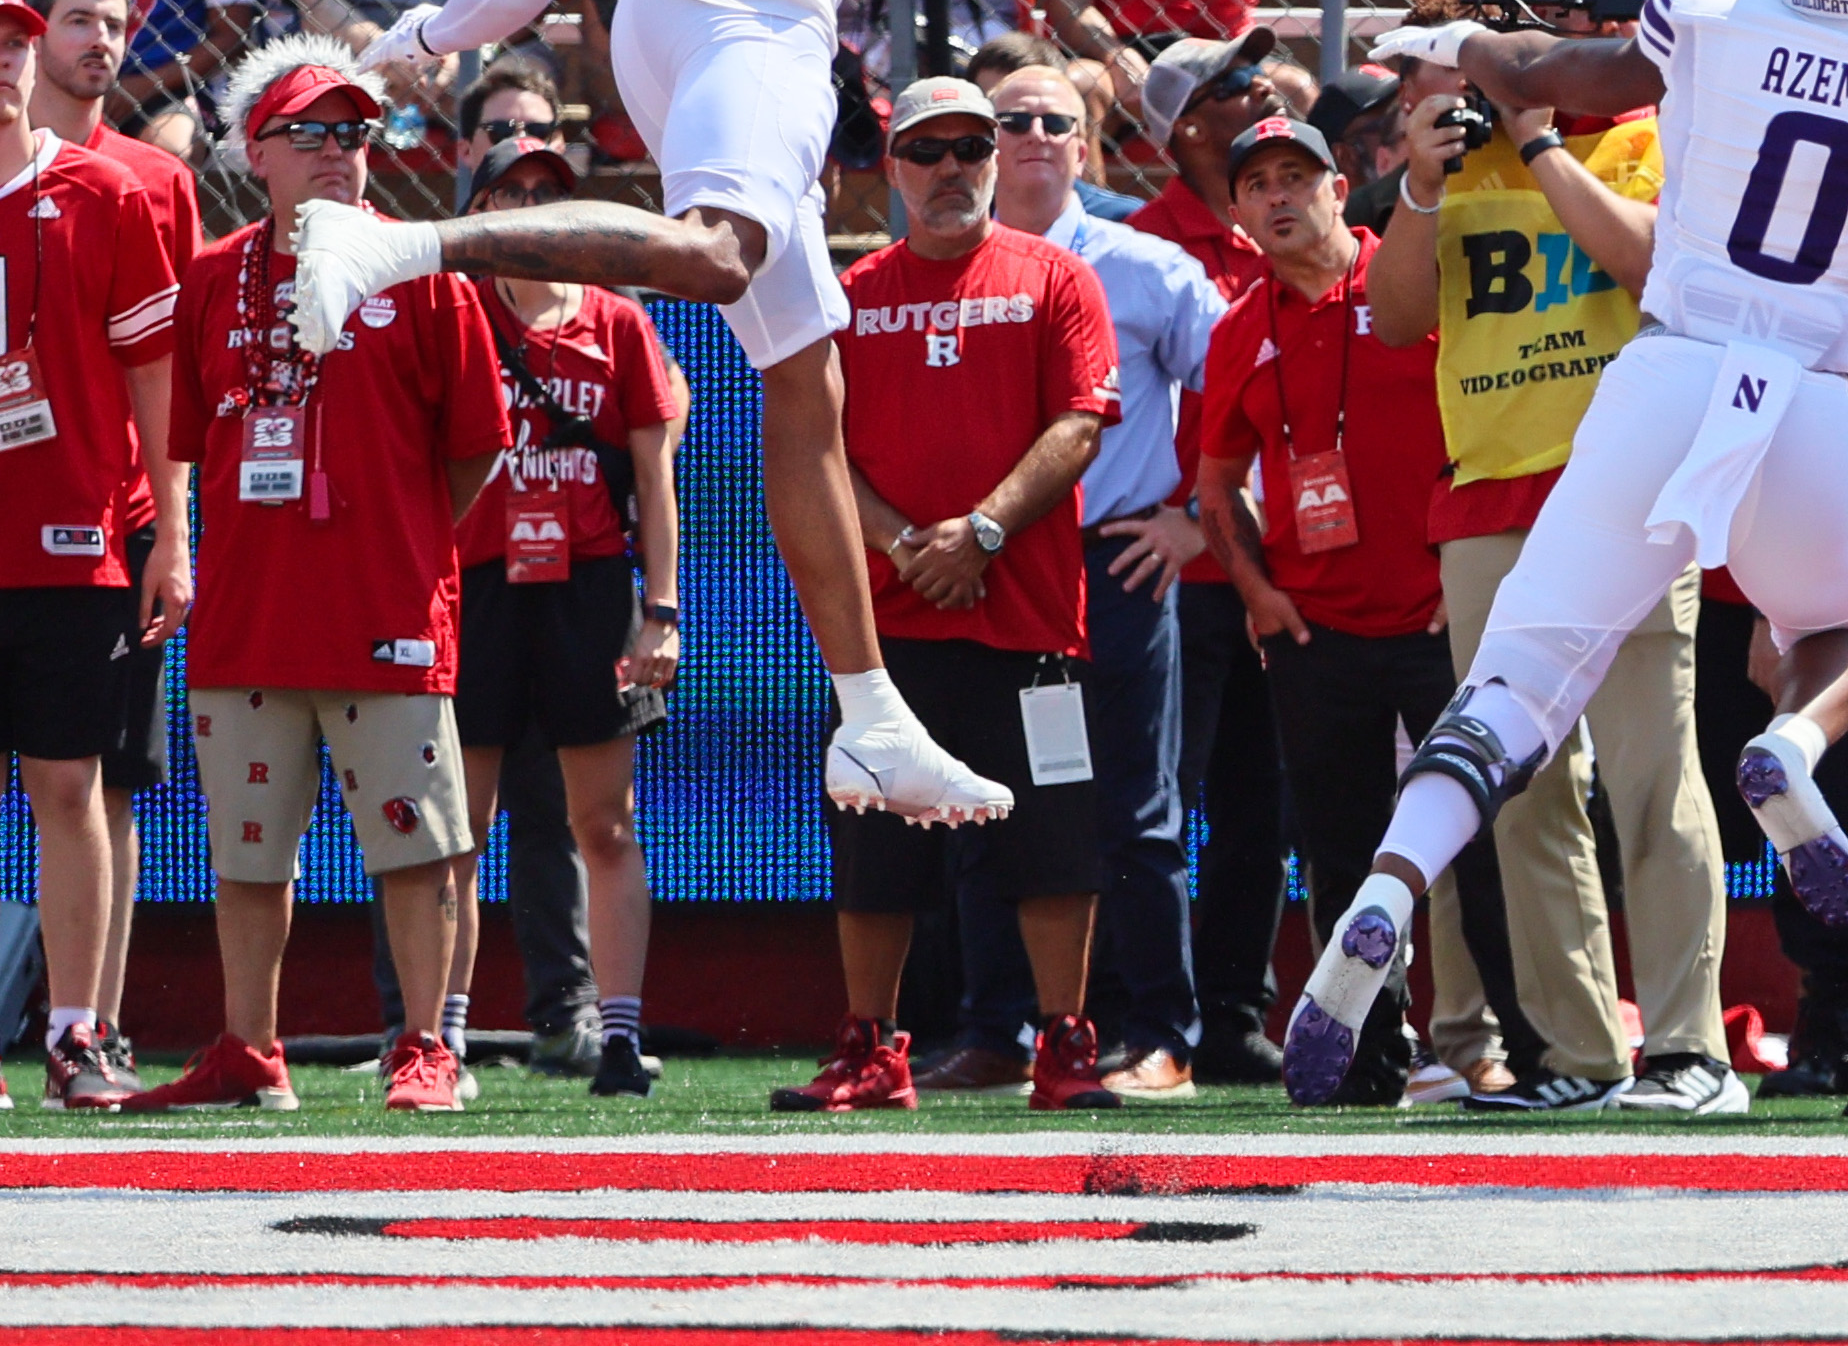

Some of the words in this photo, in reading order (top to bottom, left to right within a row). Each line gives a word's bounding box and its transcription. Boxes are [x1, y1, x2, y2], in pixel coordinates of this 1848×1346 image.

[1253, 115, 1297, 142] R
[855, 293, 1036, 338] RUTGERS
[925, 334, 961, 367] R
[1518, 330, 1587, 360] TEAM
[1460, 349, 1624, 396] VIDEOGRAPH
[1731, 373, 1769, 414] N
[1297, 483, 1349, 512] AA
[512, 520, 566, 541] AA
[196, 714, 212, 737] R
[247, 761, 270, 785] R
[241, 820, 264, 844] R
